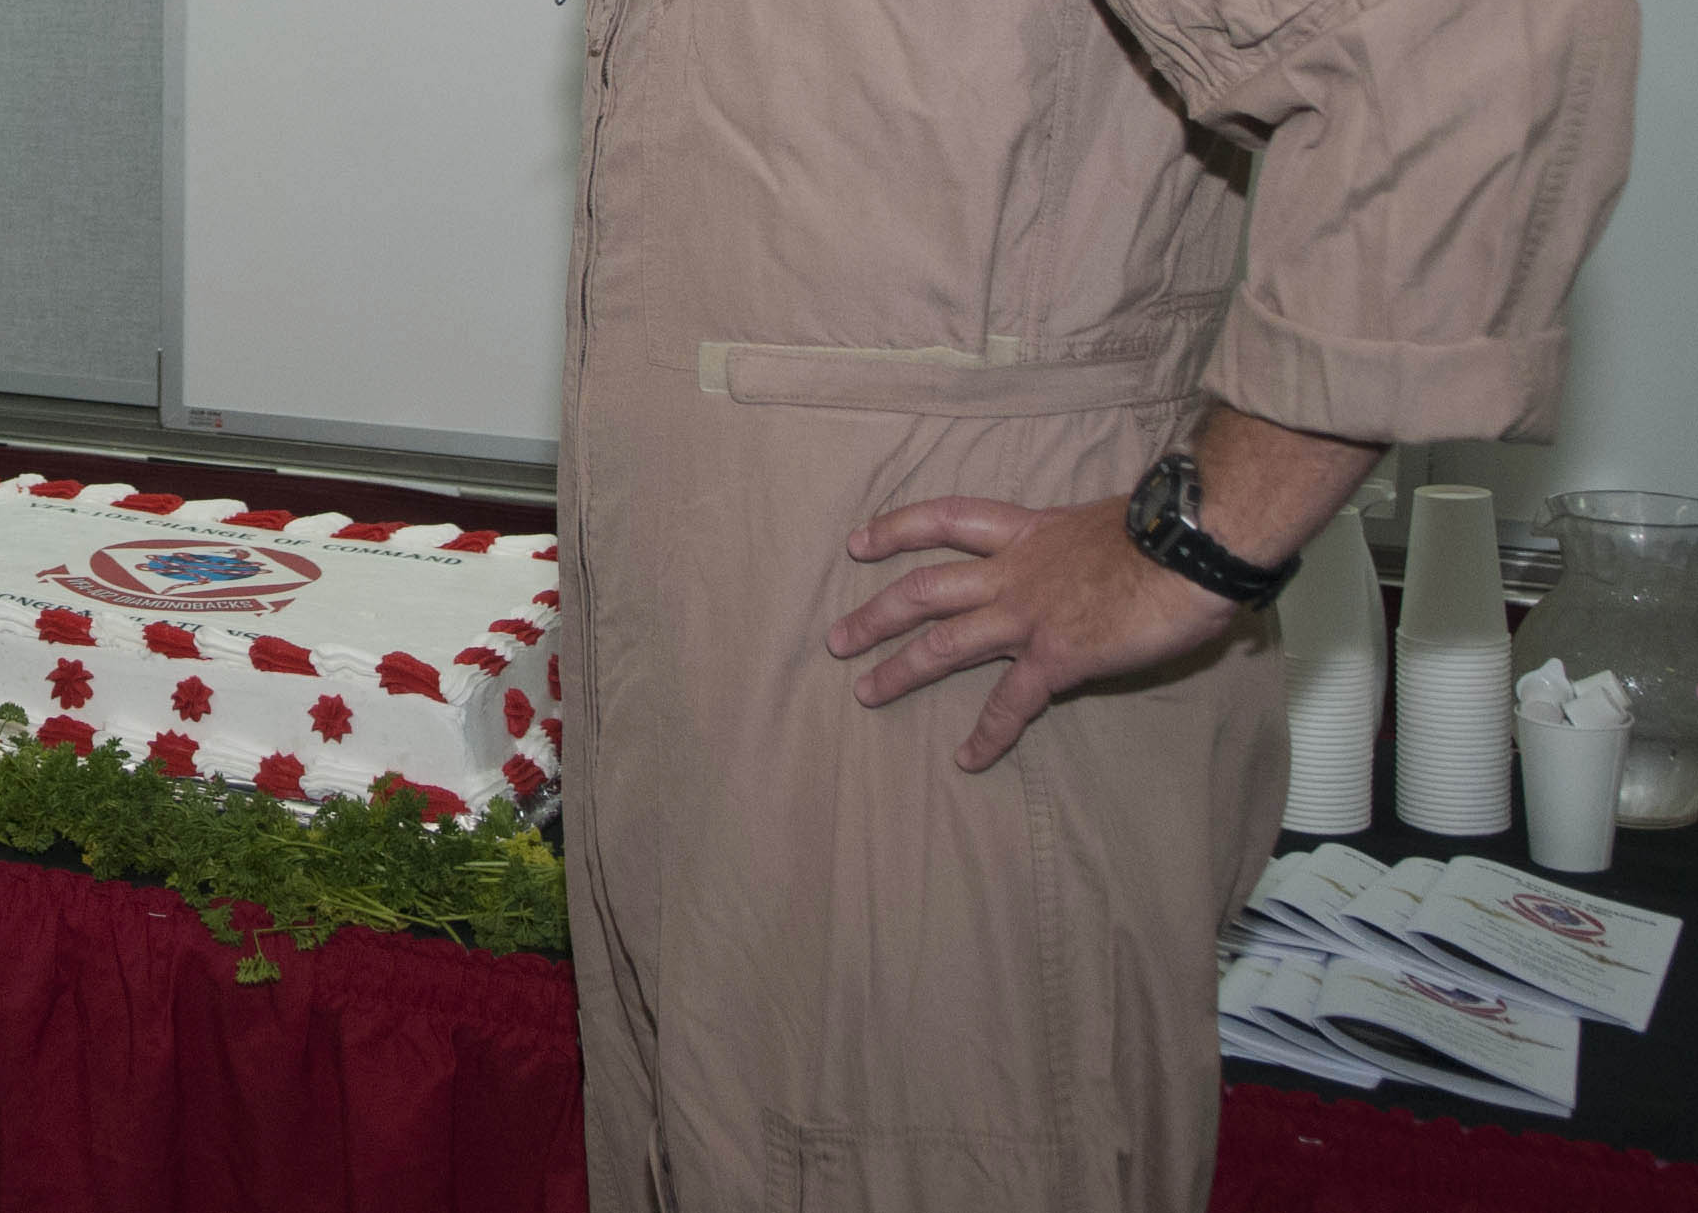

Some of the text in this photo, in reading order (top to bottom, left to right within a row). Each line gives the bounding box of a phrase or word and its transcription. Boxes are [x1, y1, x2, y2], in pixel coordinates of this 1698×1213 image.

[30, 502, 463, 565] VFA-102 CHANGE OF COMMAND
[115, 595, 253, 611] DIAMONDBACKS
